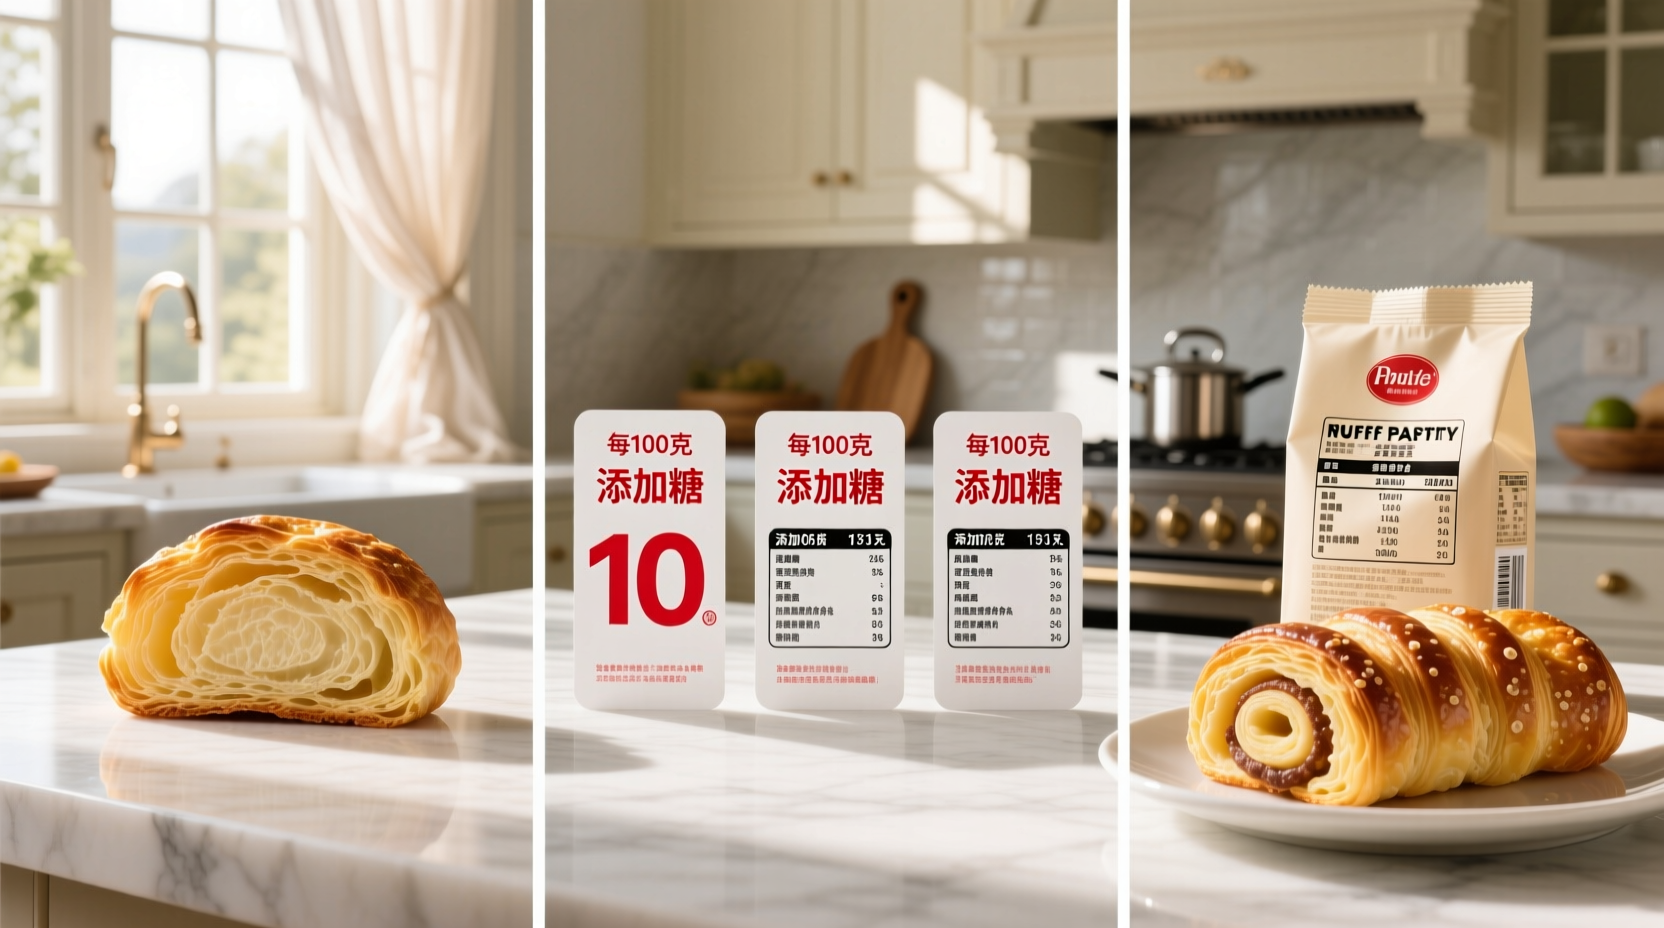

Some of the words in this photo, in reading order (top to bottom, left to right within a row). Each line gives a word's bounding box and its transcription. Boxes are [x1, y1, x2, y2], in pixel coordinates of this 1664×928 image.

[607, 432, 692, 456] 每100克
[788, 432, 873, 457] 每100克
[966, 432, 1050, 457] 每100克
[597, 467, 704, 504] 添加糖
[777, 468, 884, 505] 添加糖
[955, 468, 1062, 505] 添加糖
[589, 532, 705, 627] 10
